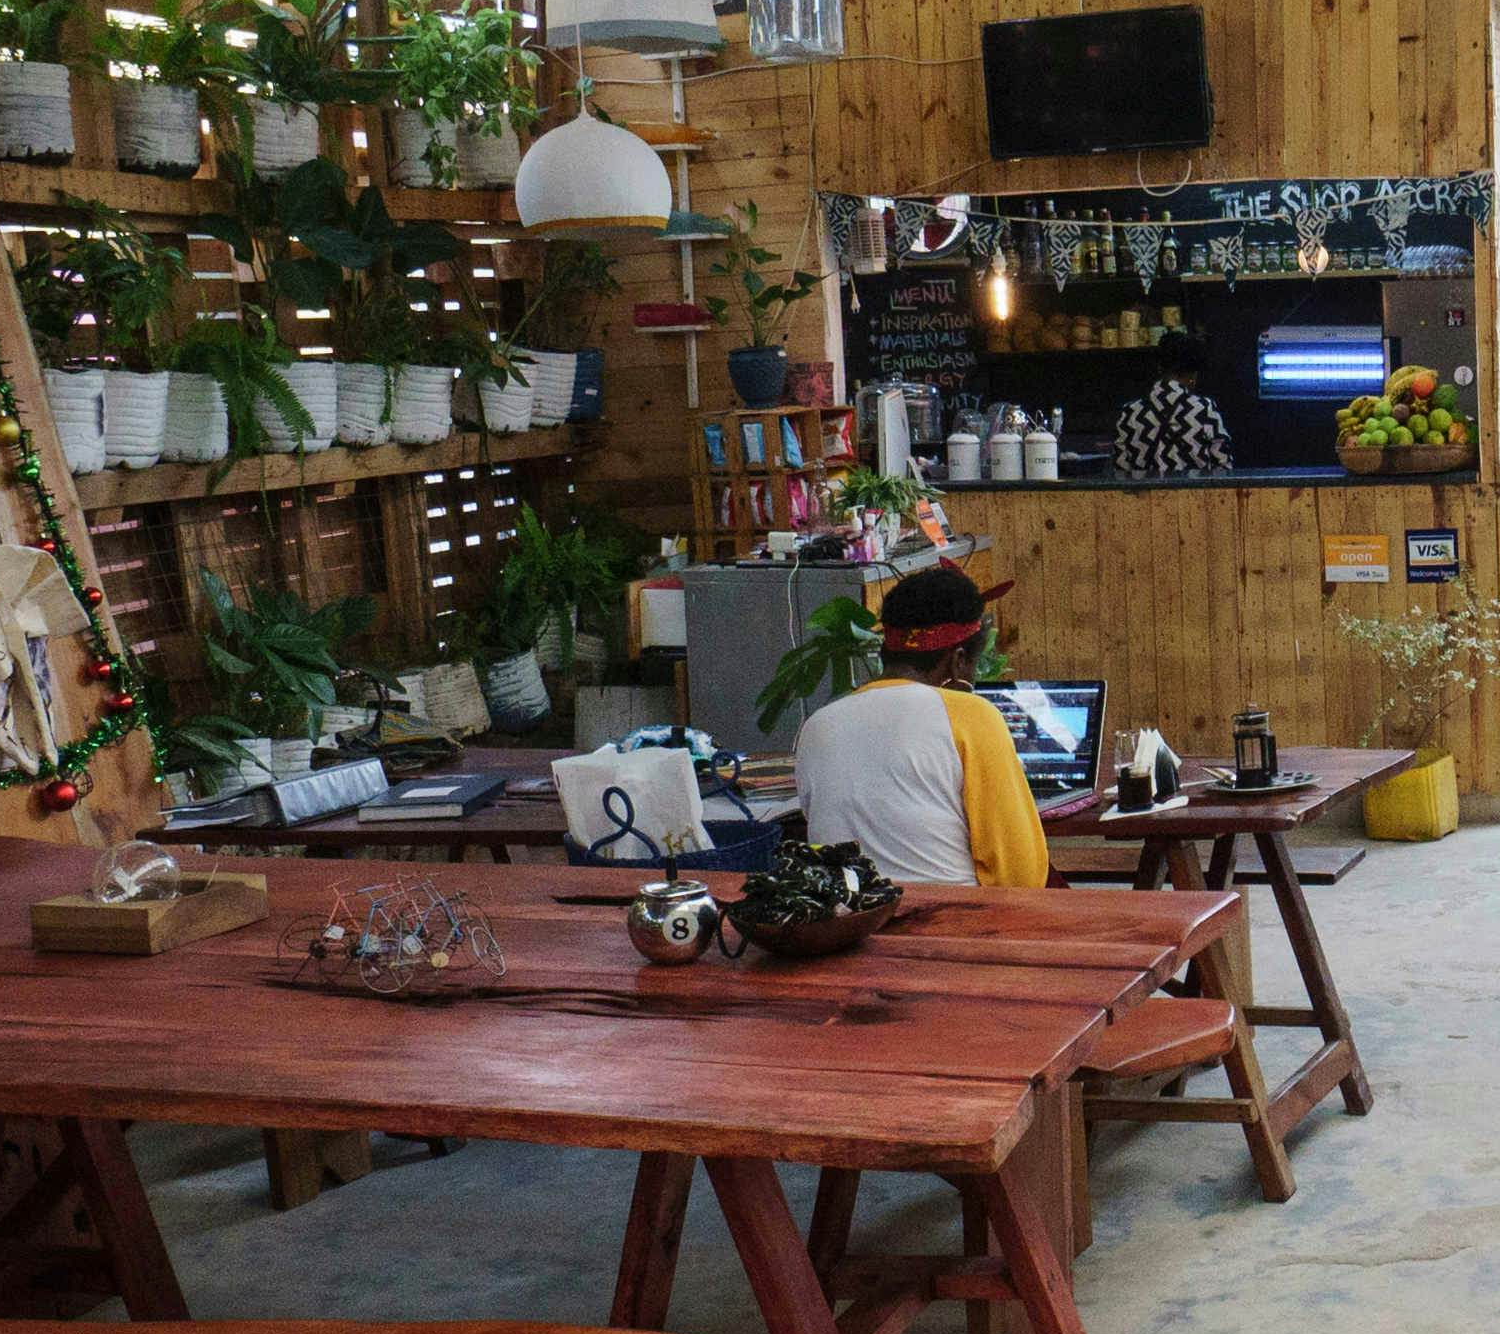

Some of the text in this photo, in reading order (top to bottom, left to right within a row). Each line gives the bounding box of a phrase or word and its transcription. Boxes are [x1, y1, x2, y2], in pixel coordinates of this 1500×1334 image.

[1210, 187, 1272, 221] THE
[893, 283, 956, 307] MENU
[880, 330, 967, 350] MATERIALS
[1340, 552, 1373, 565] open
[1416, 545, 1450, 557] VISA
